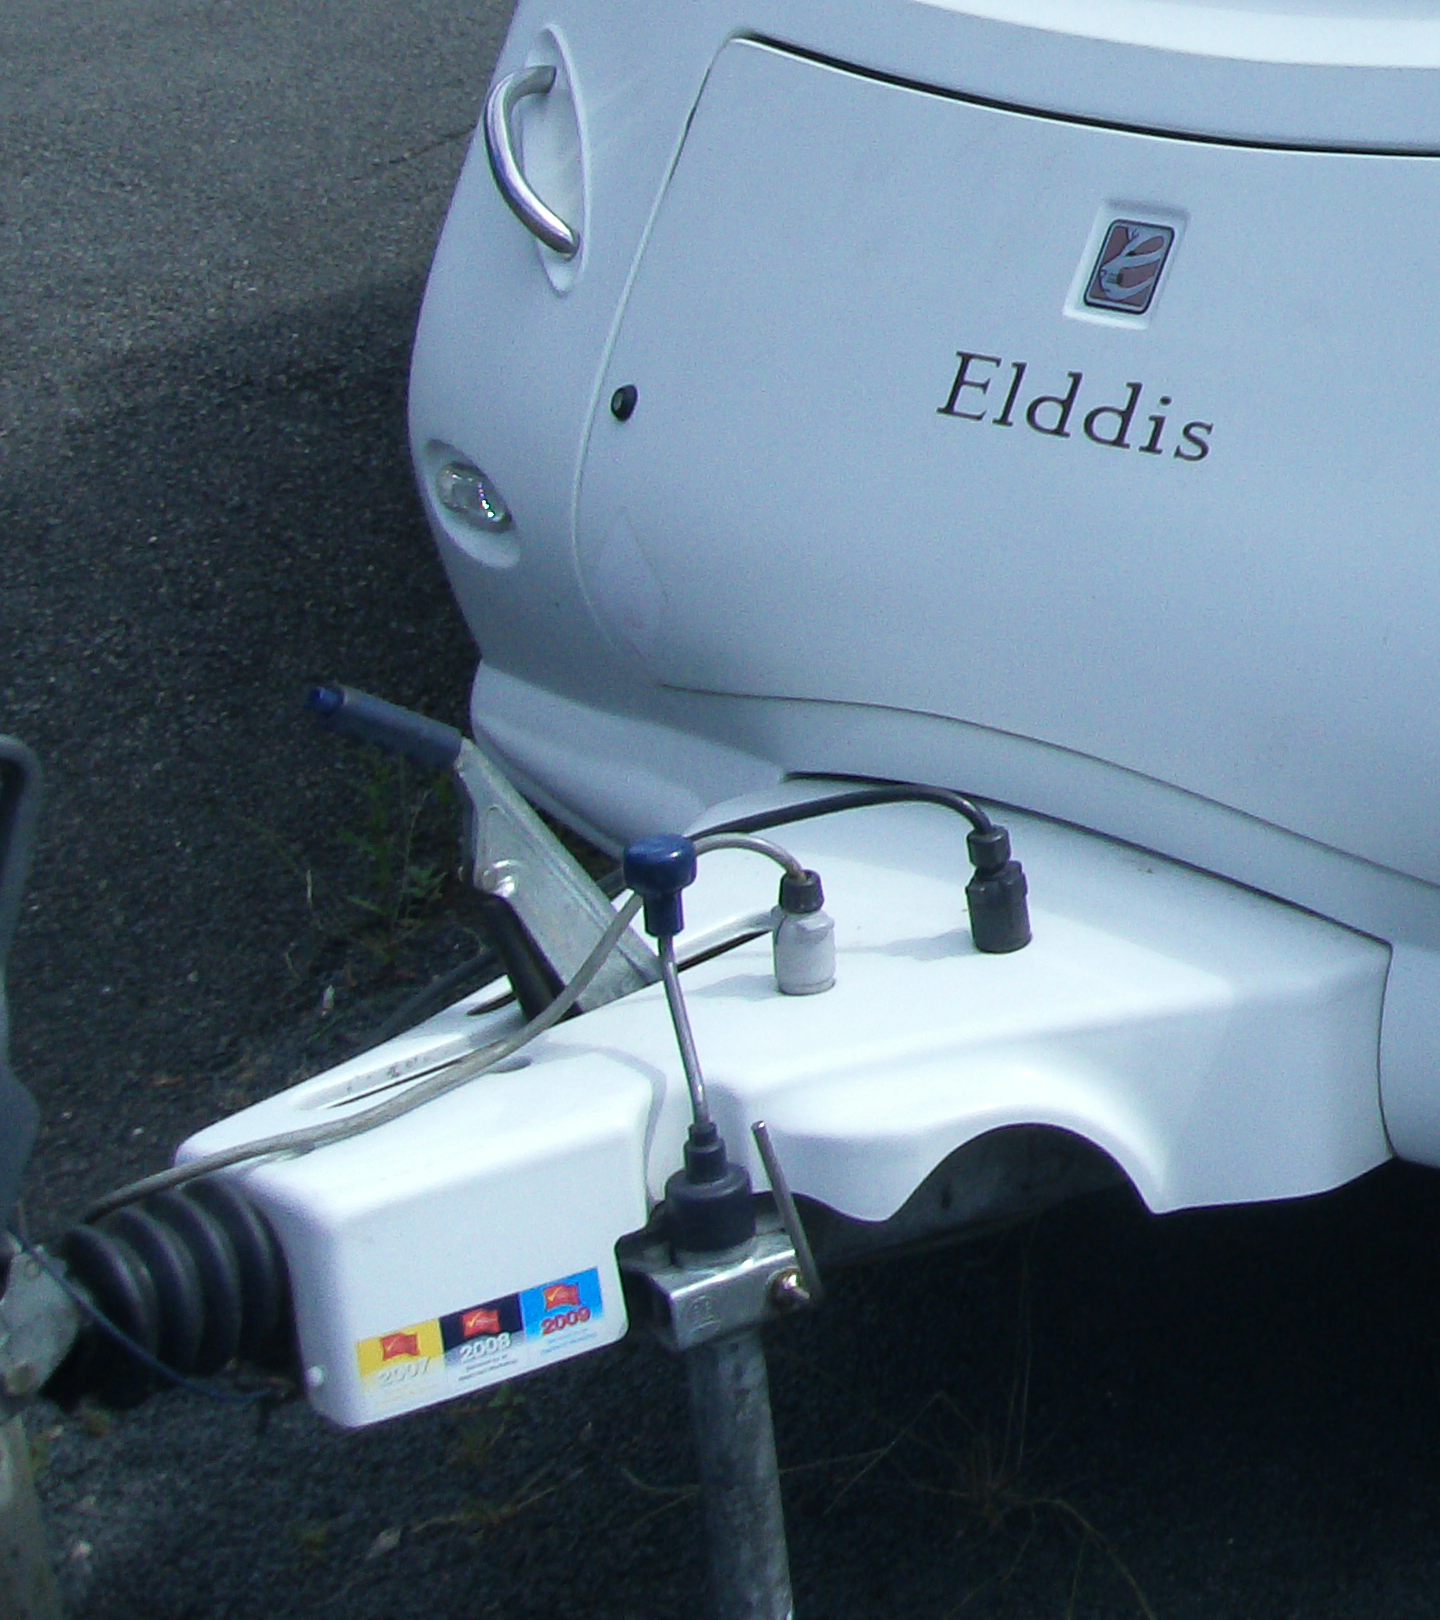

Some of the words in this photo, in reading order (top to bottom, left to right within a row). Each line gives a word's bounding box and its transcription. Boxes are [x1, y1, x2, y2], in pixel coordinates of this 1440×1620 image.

[936, 351, 1214, 462] Elddis
[541, 1308, 591, 1335] 2009
[461, 1332, 511, 1360] 2008
[378, 1356, 431, 1385] 2007
